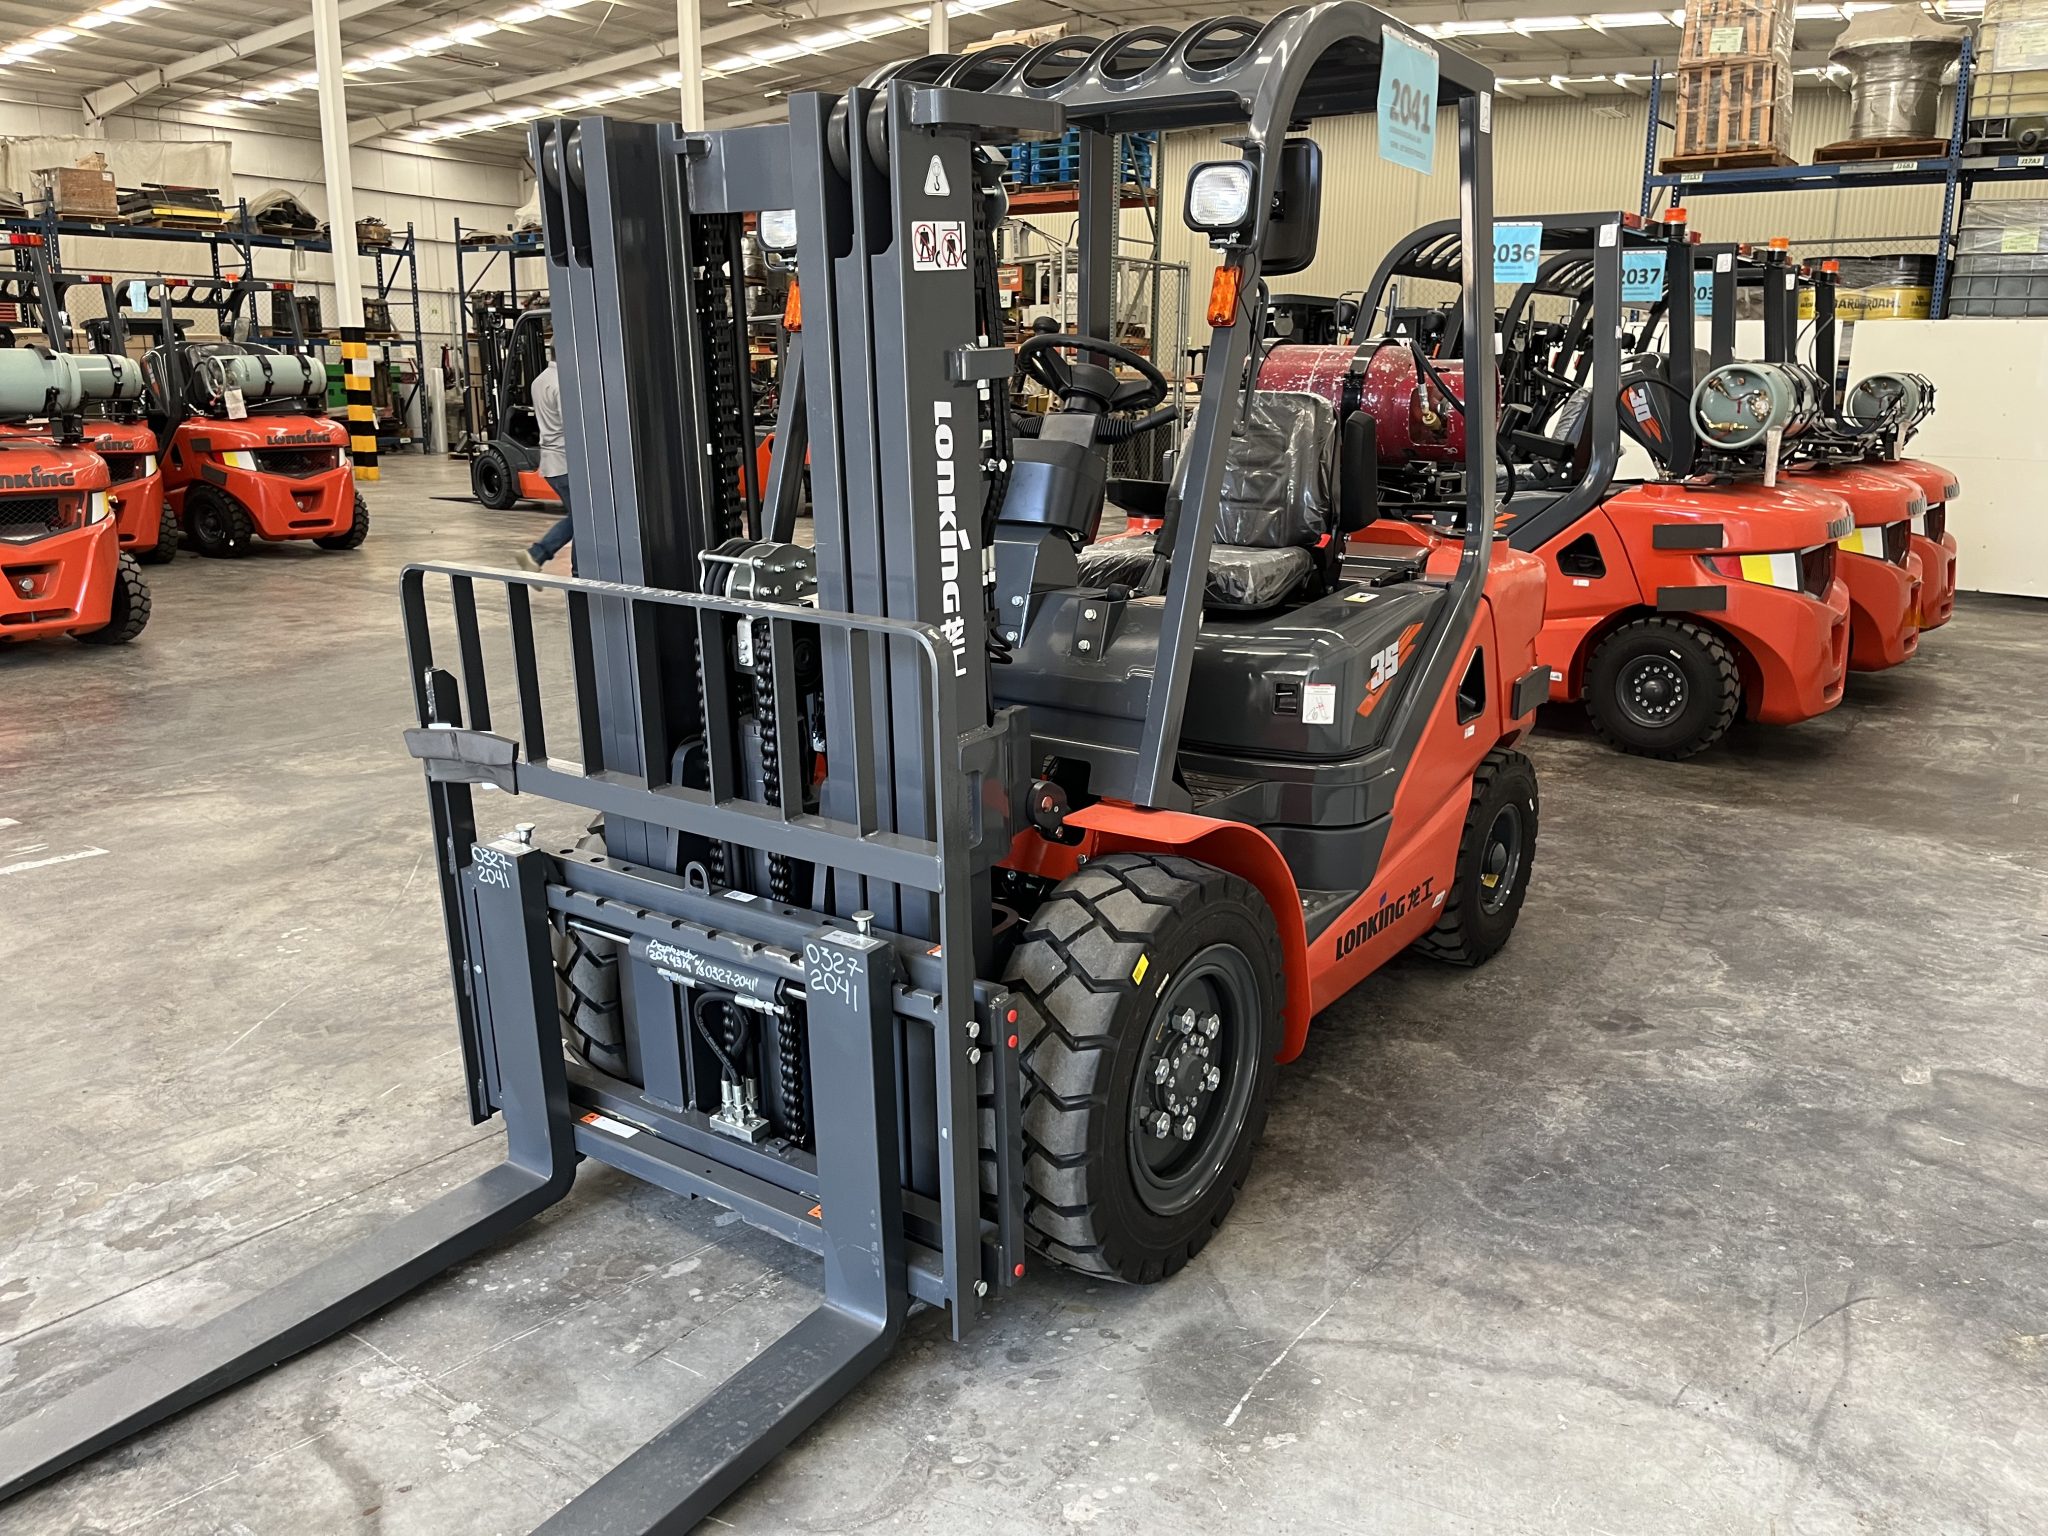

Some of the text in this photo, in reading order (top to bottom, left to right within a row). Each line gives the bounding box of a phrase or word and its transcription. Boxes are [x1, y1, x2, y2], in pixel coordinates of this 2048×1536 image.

[1390, 78, 1430, 134] 2041
[1493, 244, 1535, 263] 036
[0, 464, 75, 489] NKING
[1370, 639, 1399, 690] 35
[472, 847, 512, 870] 0327
[477, 865, 510, 888] 2041
[806, 943, 864, 977] 0327
[810, 968, 858, 1012] 2041
